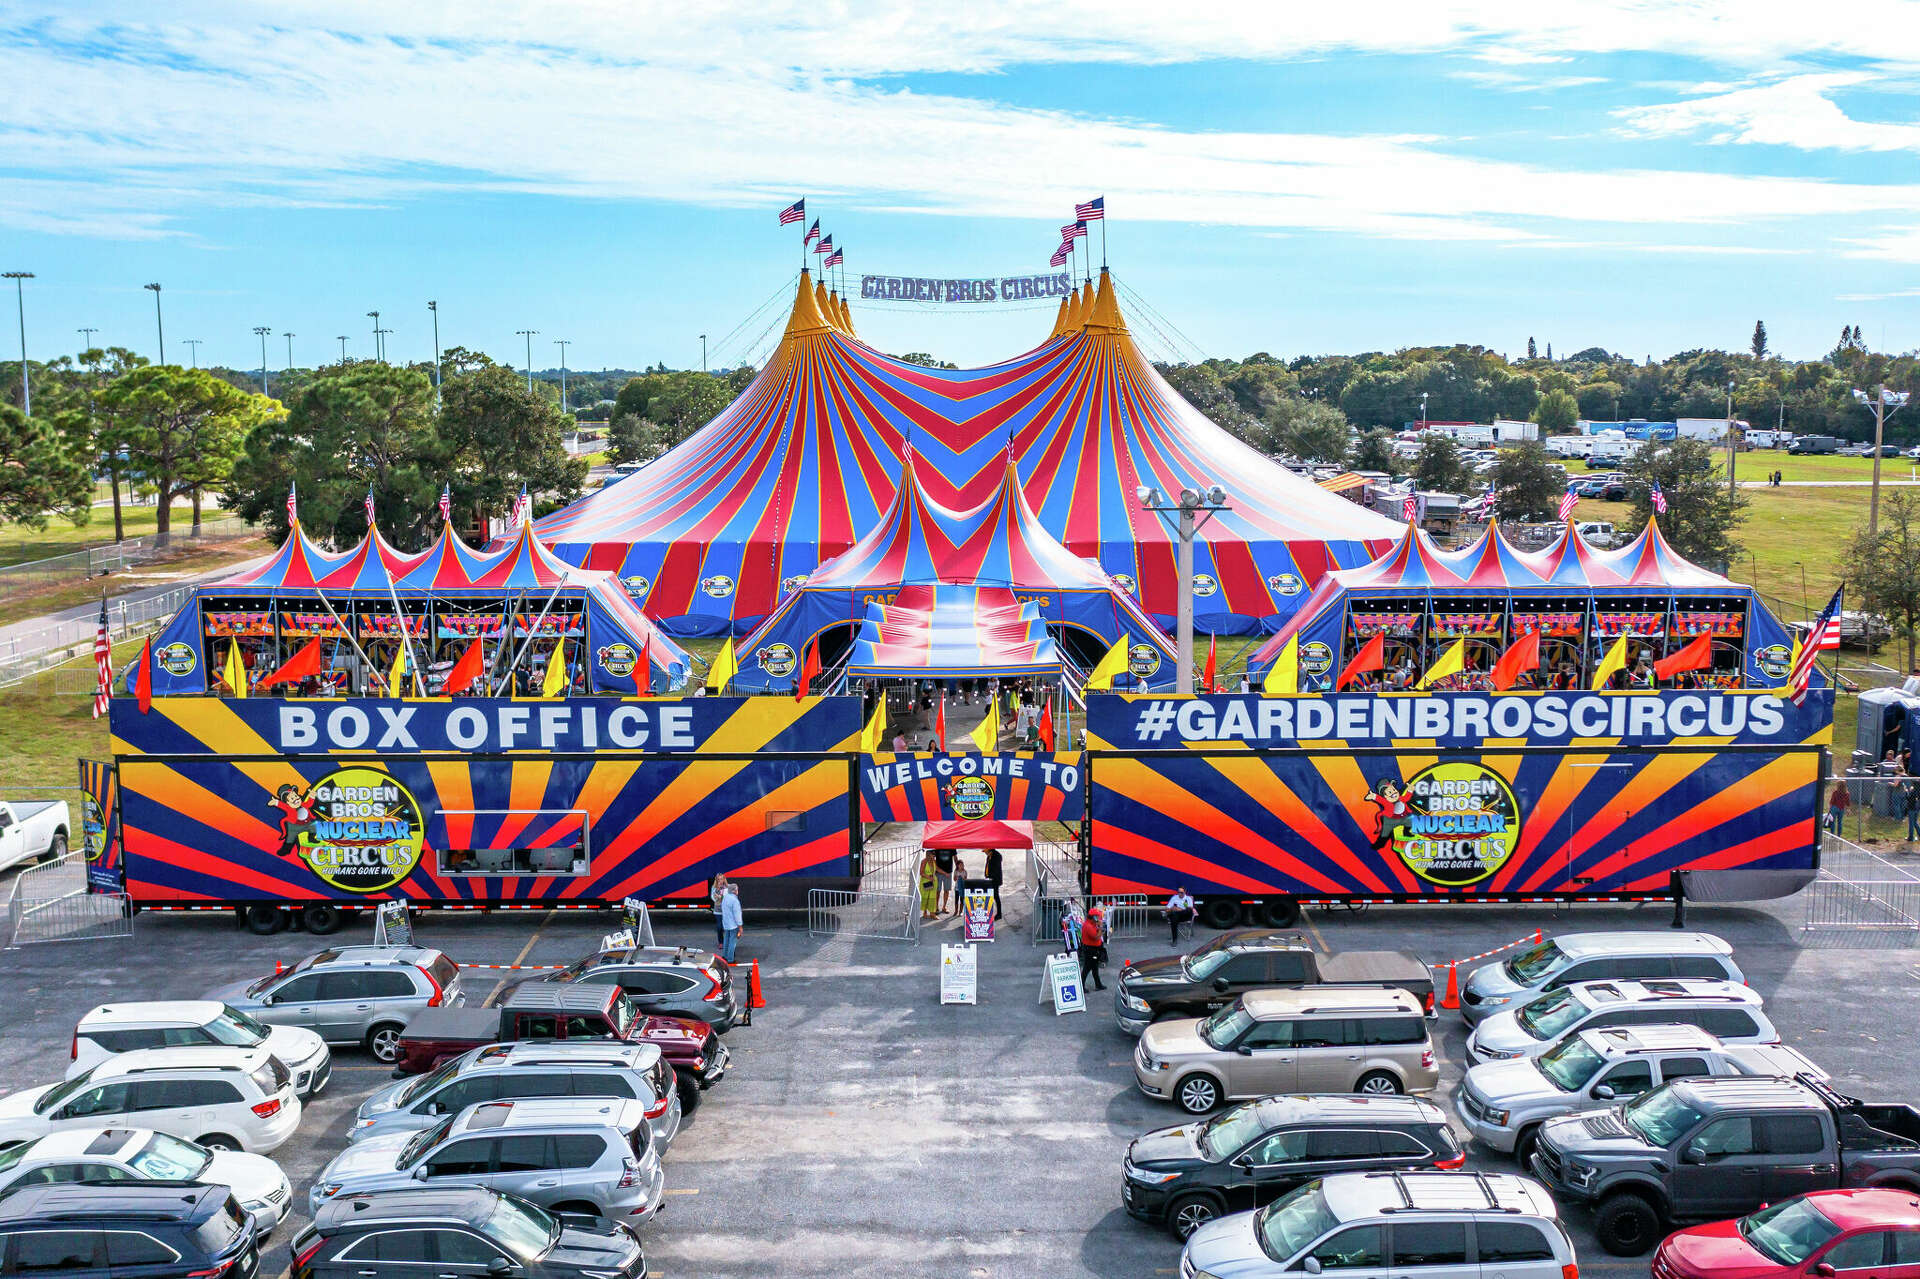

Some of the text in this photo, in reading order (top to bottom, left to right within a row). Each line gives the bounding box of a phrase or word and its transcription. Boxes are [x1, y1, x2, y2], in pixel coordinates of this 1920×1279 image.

[862, 273, 1071, 302] GARDEN BROS CIRCUS
[279, 705, 694, 749] BOX OFFICE
[1135, 695, 1784, 741] #GARDENBROSCIRCUS
[867, 757, 1078, 793] WELCOME TO
[317, 786, 399, 802] GARDEN
[1415, 780, 1497, 796] GARDEN
[331, 802, 385, 817] BROS
[1429, 796, 1482, 811] BROS
[315, 820, 413, 840] NUCLEAR
[1411, 814, 1508, 834] NUCLEAR
[310, 845, 412, 866] CIRCUS
[1404, 839, 1506, 860] CIRCUS
[322, 867, 356, 875] HUMANS
[357, 867, 380, 875] GONE
[1450, 860, 1472, 869] GONE
